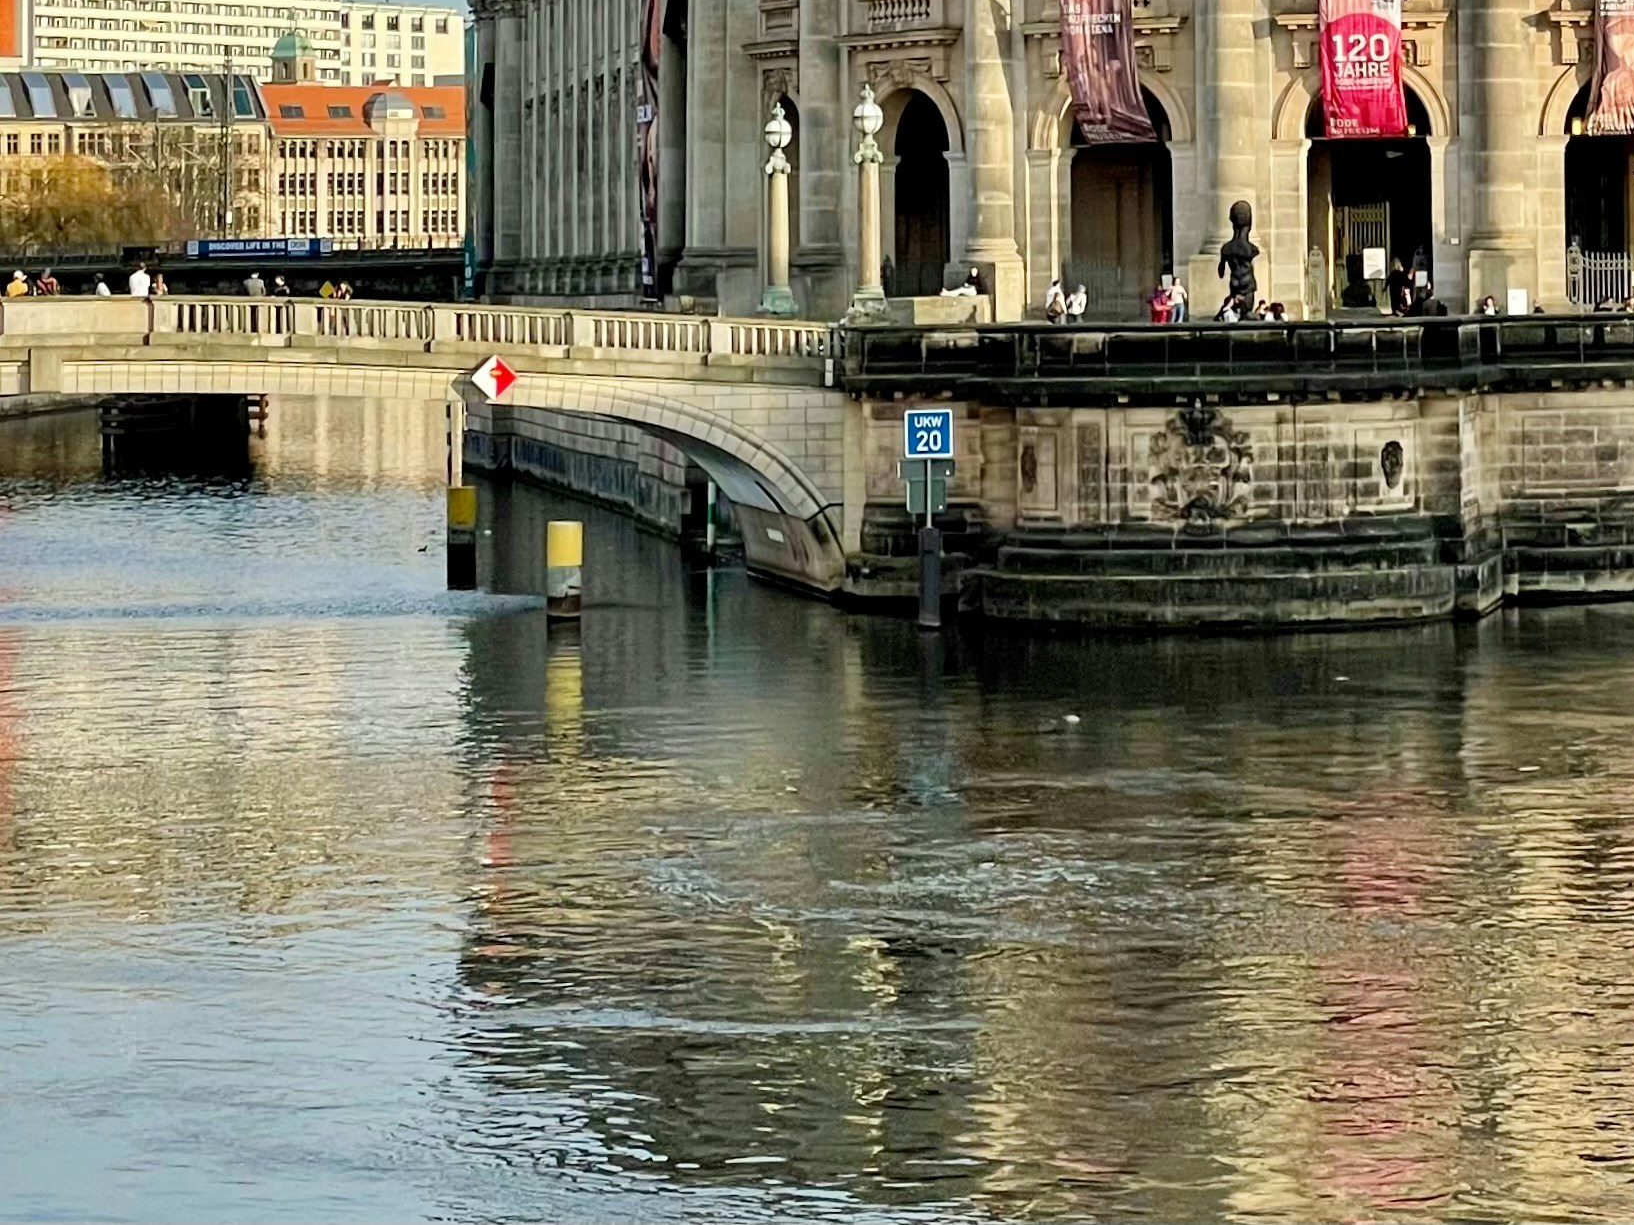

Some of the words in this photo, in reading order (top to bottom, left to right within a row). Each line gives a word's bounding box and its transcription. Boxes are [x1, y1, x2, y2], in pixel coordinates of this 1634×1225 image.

[1332, 33, 1391, 62] 120
[1334, 61, 1391, 78] JAHRE
[208, 241, 245, 251] DISCOVER
[245, 241, 261, 251] LIFE
[262, 241, 271, 250] IN
[272, 241, 286, 250] THE
[914, 415, 943, 428] UKW
[916, 430, 942, 452] 20
